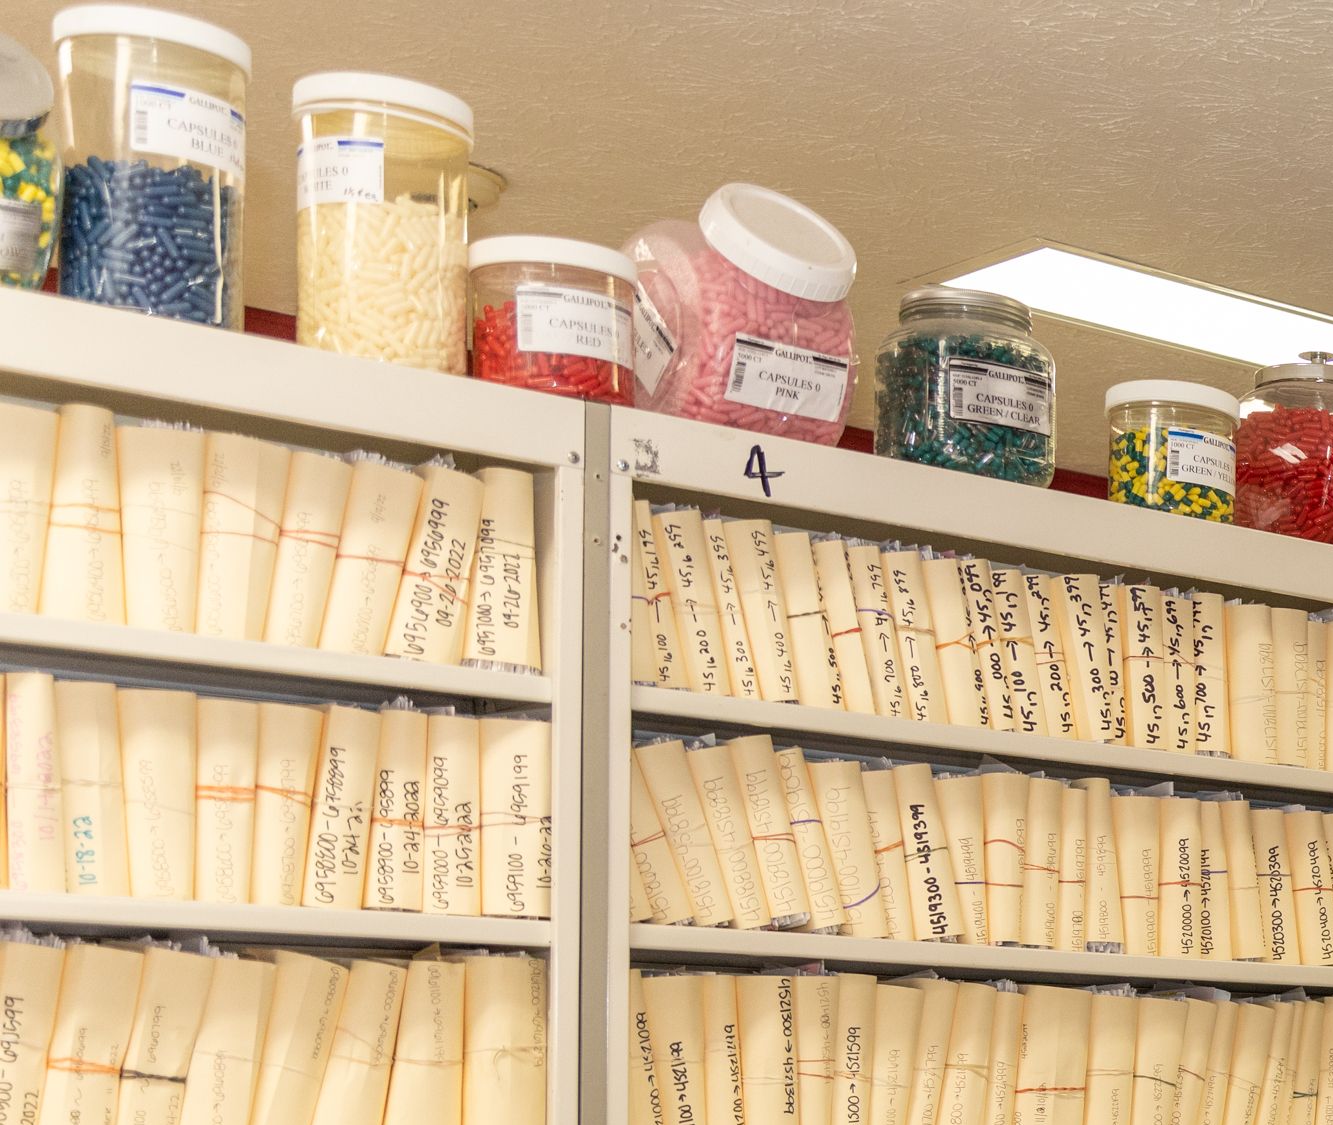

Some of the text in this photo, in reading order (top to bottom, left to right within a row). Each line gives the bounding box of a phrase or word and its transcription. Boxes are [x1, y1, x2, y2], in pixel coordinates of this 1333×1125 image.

[167, 119, 233, 147] CAPSULES
[191, 138, 224, 157] BLUE
[550, 318, 612, 337] CAPSULES
[576, 335, 602, 347] RED
[759, 370, 821, 392] CAPSULES 0
[775, 386, 800, 400] PINK
[976, 392, 1034, 412] CAPSULES 0
[968, 403, 1040, 425] GREEN CLEAR
[743, 445, 785, 497] 4
[1181, 464, 1212, 476] GREEN
[1193, 454, 1231, 472] CAPSULES
[421, 498, 449, 569] 6956999
[479, 518, 496, 585] 6957099
[433, 756, 448, 826] 6959099
[511, 754, 530, 826] 6959199
[72, 815, 98, 885] 10-18-22
[909, 804, 931, 864] 4519399
[1267, 845, 1283, 897] 4520399
[927, 877, 949, 936] 4519300
[1181, 904, 1194, 955] 4520000
[1200, 911, 1214, 955] 4520100
[1271, 910, 1286, 961] 4520300
[1318, 906, 1333, 960] 4520400
[777, 978, 793, 1038] 4521300
[782, 1057, 795, 1116] 4521399
